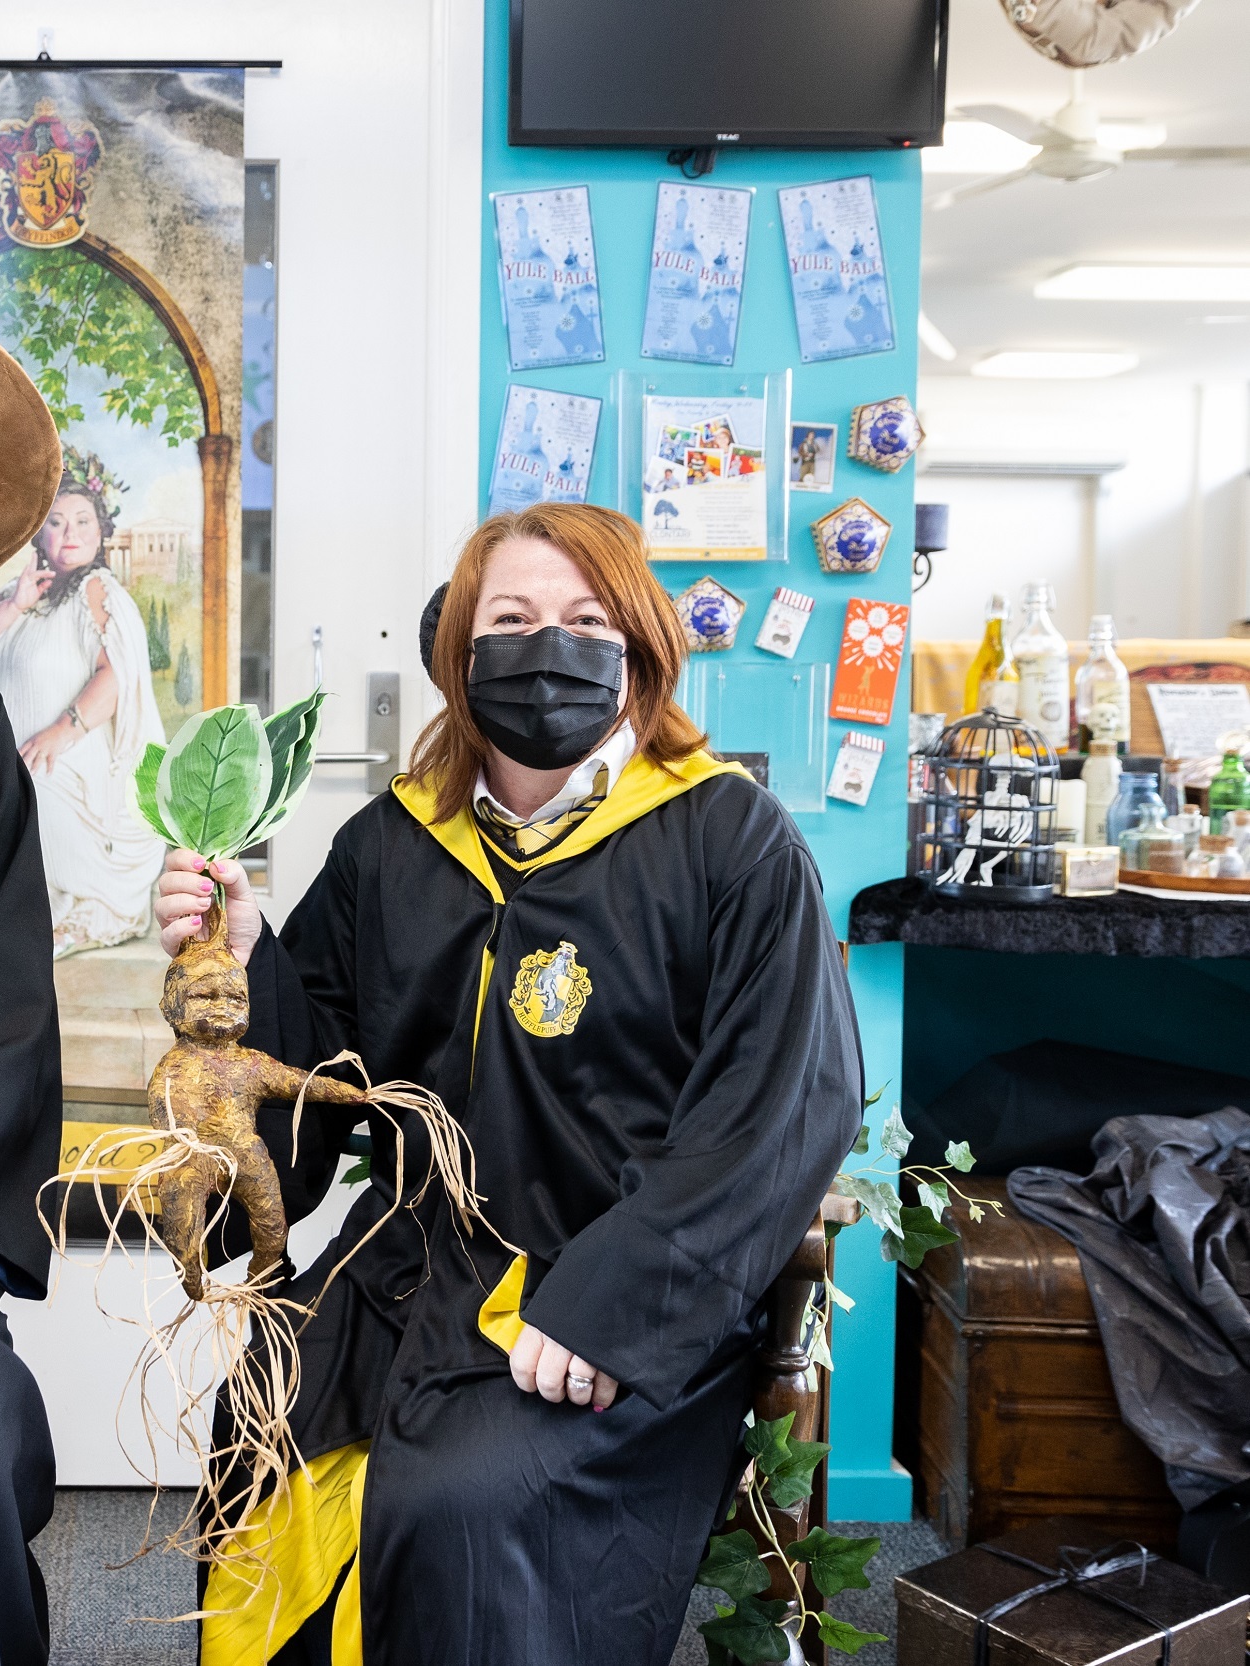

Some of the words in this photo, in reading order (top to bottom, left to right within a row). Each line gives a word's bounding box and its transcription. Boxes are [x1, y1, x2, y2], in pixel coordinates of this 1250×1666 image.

[716, 133, 740, 141] TEAC
[16, 225, 75, 242] GRYFFINDOR
[504, 260, 547, 280] YULE
[552, 268, 595, 285] BALL
[652, 250, 695, 274] YULE
[700, 266, 740, 286] BALL
[790, 254, 833, 275] YULE
[840, 256, 881, 275] BALL
[500, 452, 541, 477] YULE
[544, 469, 585, 492] BALL
[517, 1012, 555, 1033] HUFFLEPUFF
